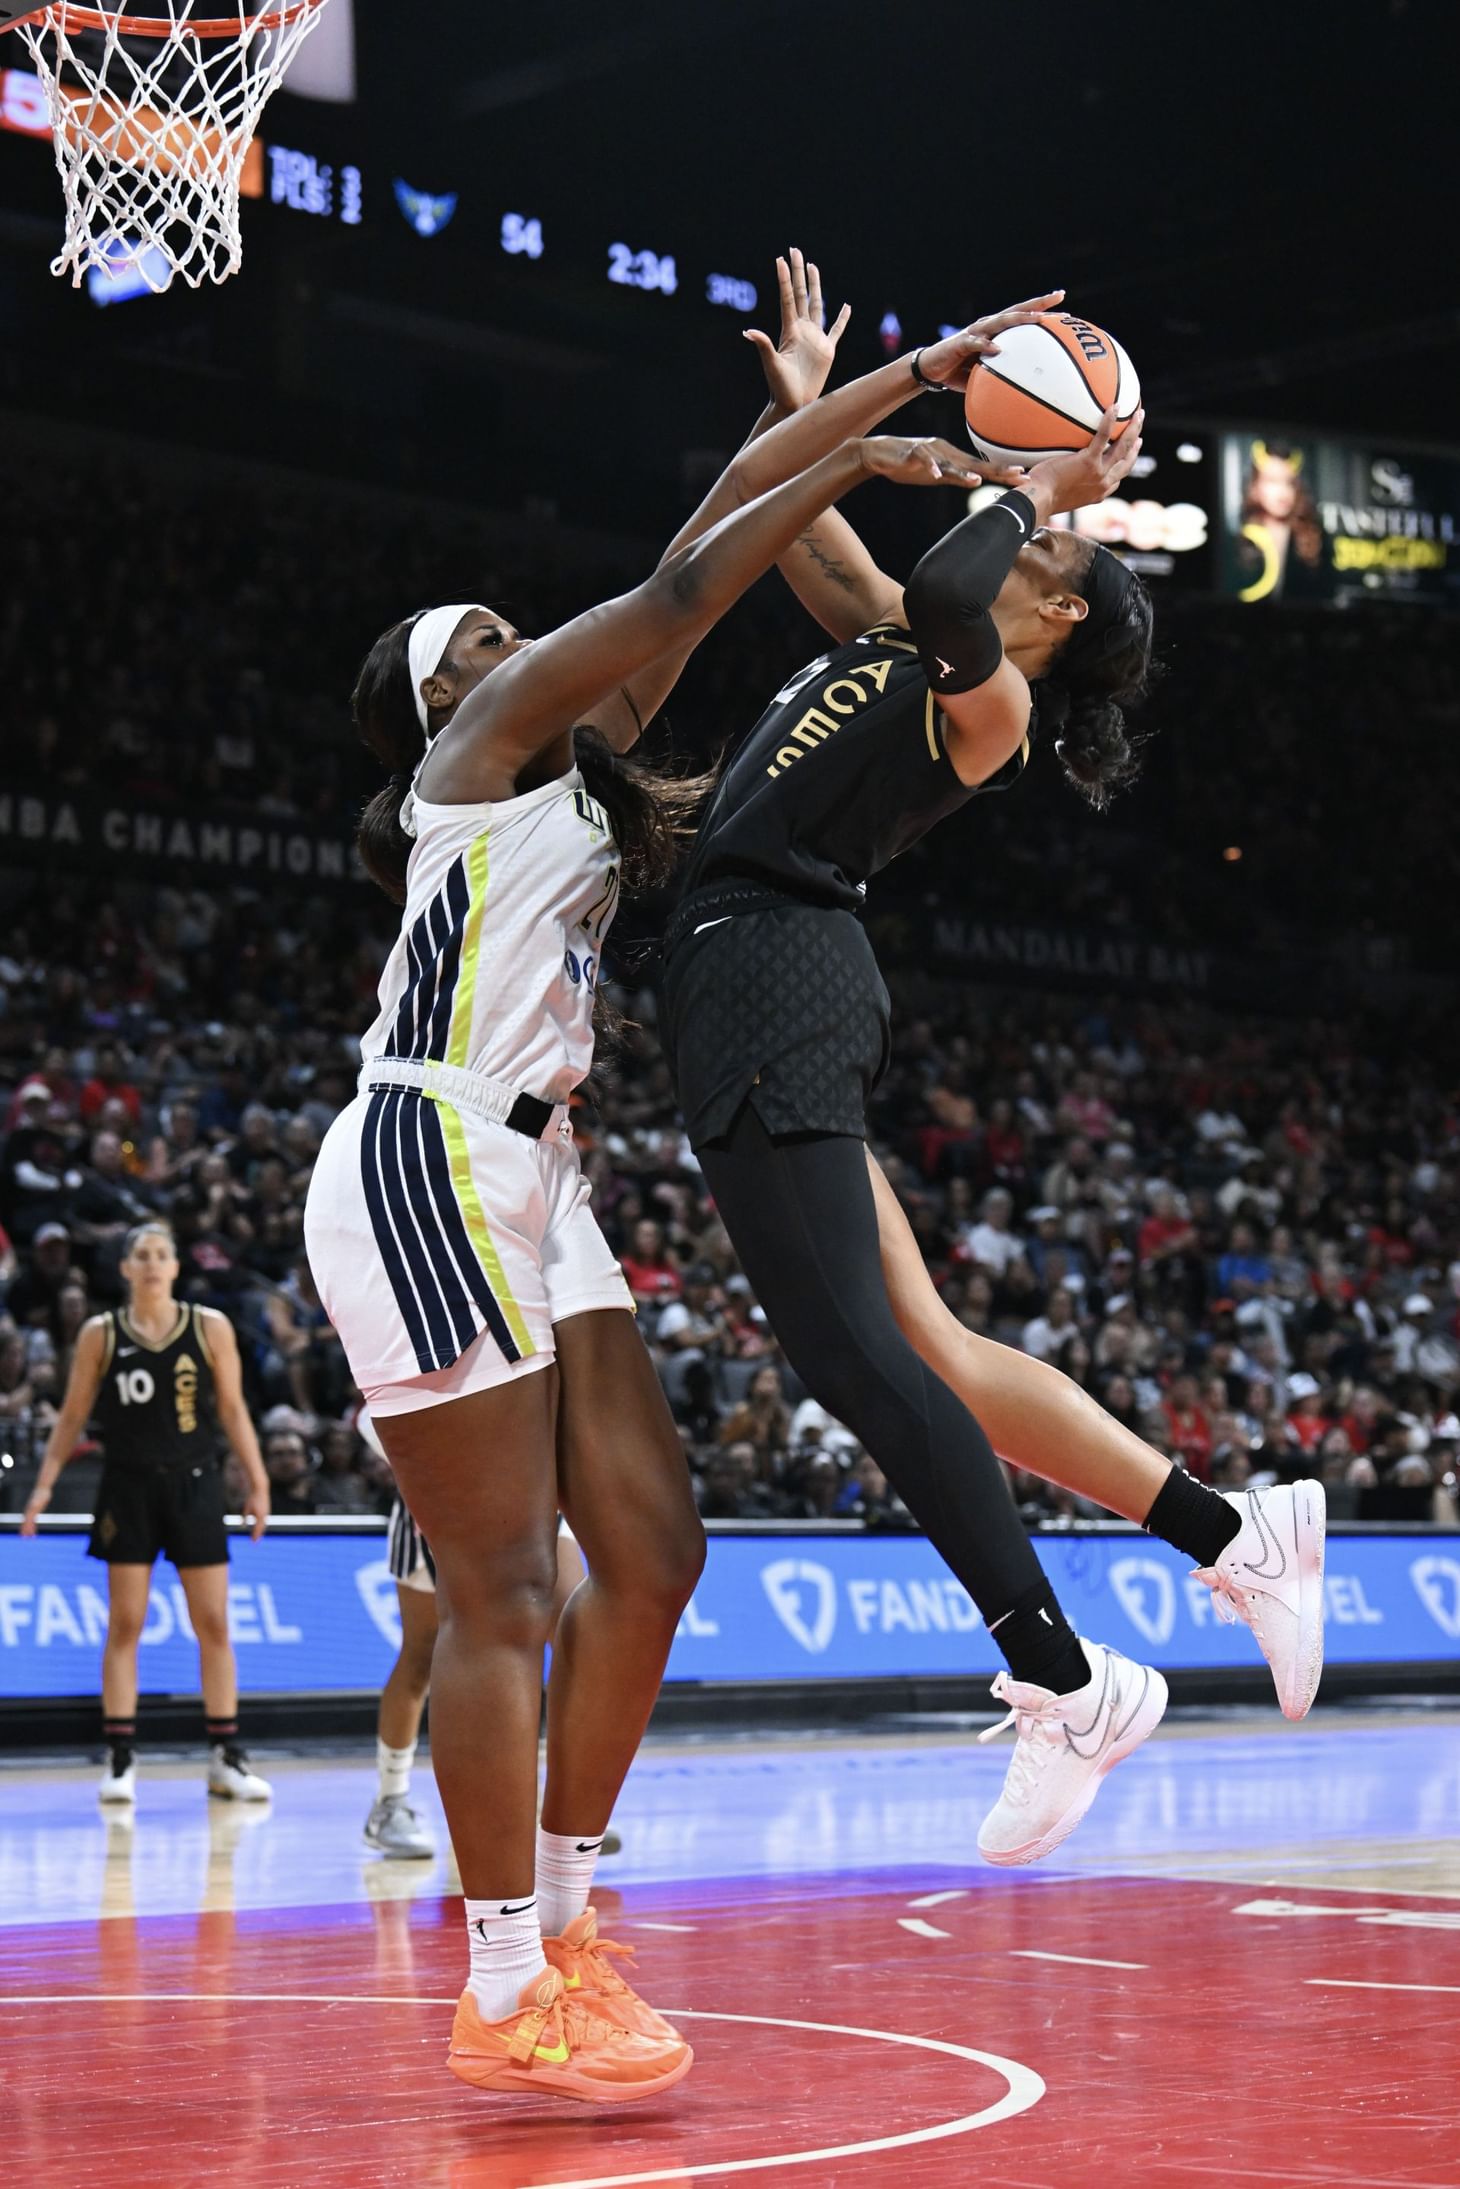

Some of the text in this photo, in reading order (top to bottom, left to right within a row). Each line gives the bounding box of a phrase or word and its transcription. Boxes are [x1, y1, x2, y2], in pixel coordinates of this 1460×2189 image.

[501, 212, 544, 260] 54
[116, 1369, 155, 1405] 10
[174, 1354, 198, 1433] ACES
